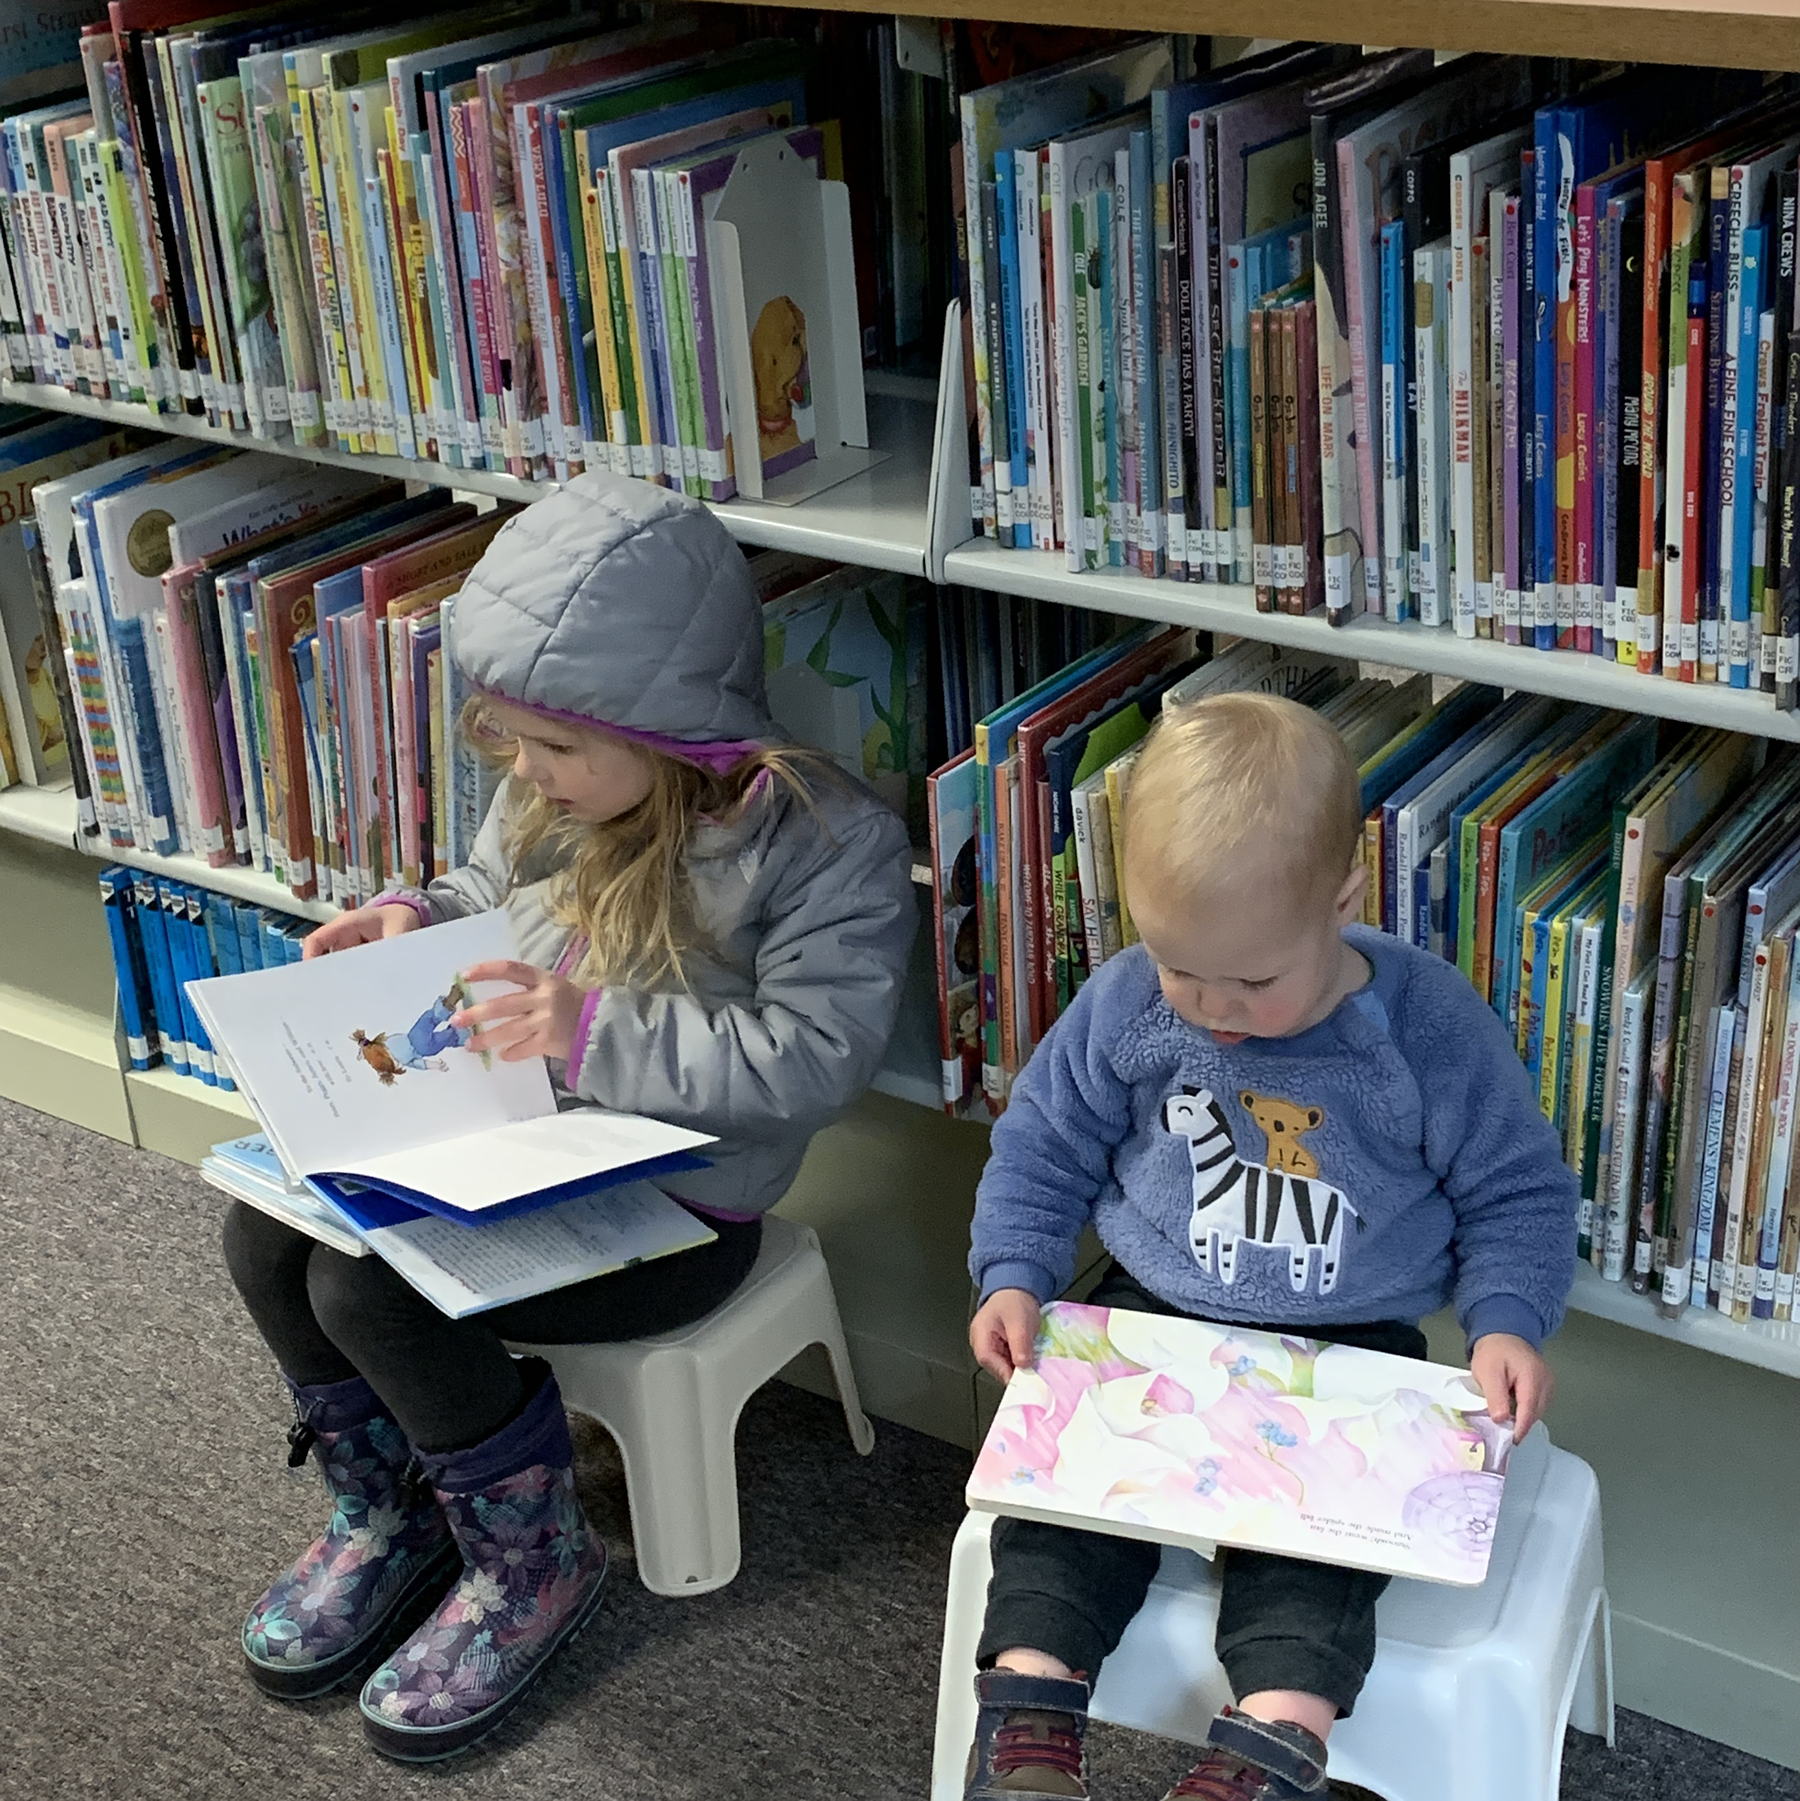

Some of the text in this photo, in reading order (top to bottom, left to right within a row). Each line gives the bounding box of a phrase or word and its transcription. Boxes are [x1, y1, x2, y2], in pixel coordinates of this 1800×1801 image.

[396, 128, 406, 152] Day
[531, 145, 548, 218] VERY LULU
[1313, 158, 1328, 228] JON AGEE
[1406, 169, 1415, 203] COPPO
[1116, 184, 1125, 223] COLE
[1535, 193, 1547, 221] Birds!
[1505, 220, 1517, 280] Ben Cort
[1558, 238, 1571, 265] Fish!
[1727, 181, 1742, 291] CREECH BLISS
[1780, 197, 1796, 278] NINA CREWS
[560, 251, 575, 323] STELLALUNA
[1133, 272, 1144, 306] BEAR
[1180, 280, 1191, 313] DOLL
[1525, 268, 1534, 291] RITA
[327, 287, 340, 332] CHAIR!
[1075, 252, 1089, 386] COLE JACK'S GARDEN
[1120, 298, 1131, 327] Spot
[1708, 214, 1724, 408] CRAFT SLEEPING BEAUTY
[1180, 317, 1191, 348] FACE
[1576, 216, 1591, 482] Let's Play MONSTERS! Lucy Cousins
[1137, 348, 1147, 385] CHAIR
[1182, 353, 1193, 379] HAS
[1209, 255, 1225, 477] THE SECRET-KEEPER
[1558, 362, 1571, 388] Lucy
[1492, 342, 1502, 429] Finds Thing
[1722, 367, 1737, 405] FINE,
[1183, 394, 1195, 437] PARTY!
[1321, 366, 1334, 458] LIFE ON MARS
[1456, 390, 1469, 463] MILKMAN
[1536, 414, 1547, 440] Lucy
[1559, 391, 1571, 434] Cousins
[1641, 372, 1655, 479] AROUND THE WORLD
[1721, 410, 1735, 442] FINE
[1754, 340, 1771, 490] Crews Freight Train
[1535, 442, 1546, 478] Cousins
[1720, 447, 1733, 509] SCHOOL
[1783, 486, 1795, 518] Where's
[1074, 807, 1086, 843] davick
[1398, 833, 1408, 872] Randall
[1053, 869, 1066, 955] WHILE GRANDPA
[1082, 898, 1097, 923] SAY
[1001, 943, 1009, 967] DALE
[1617, 944, 1630, 989] DRAGON
[1740, 926, 1754, 982] DEMAREST
[1657, 982, 1669, 1008] THE
[1543, 1036, 1555, 1058] Pete
[1591, 965, 1613, 1121] SNOWMEN LIVE FOREVER
[1788, 1022, 1799, 1038] The
[1784, 1041, 1797, 1077] DONKEY
[1612, 1112, 1627, 1150] RALPH'S
[1777, 1114, 1789, 1138] ROCK
[1610, 1152, 1624, 1186] ROTTEN
[1609, 1188, 1621, 1206] DAY
[1698, 1164, 1717, 1233] KINGDOM
